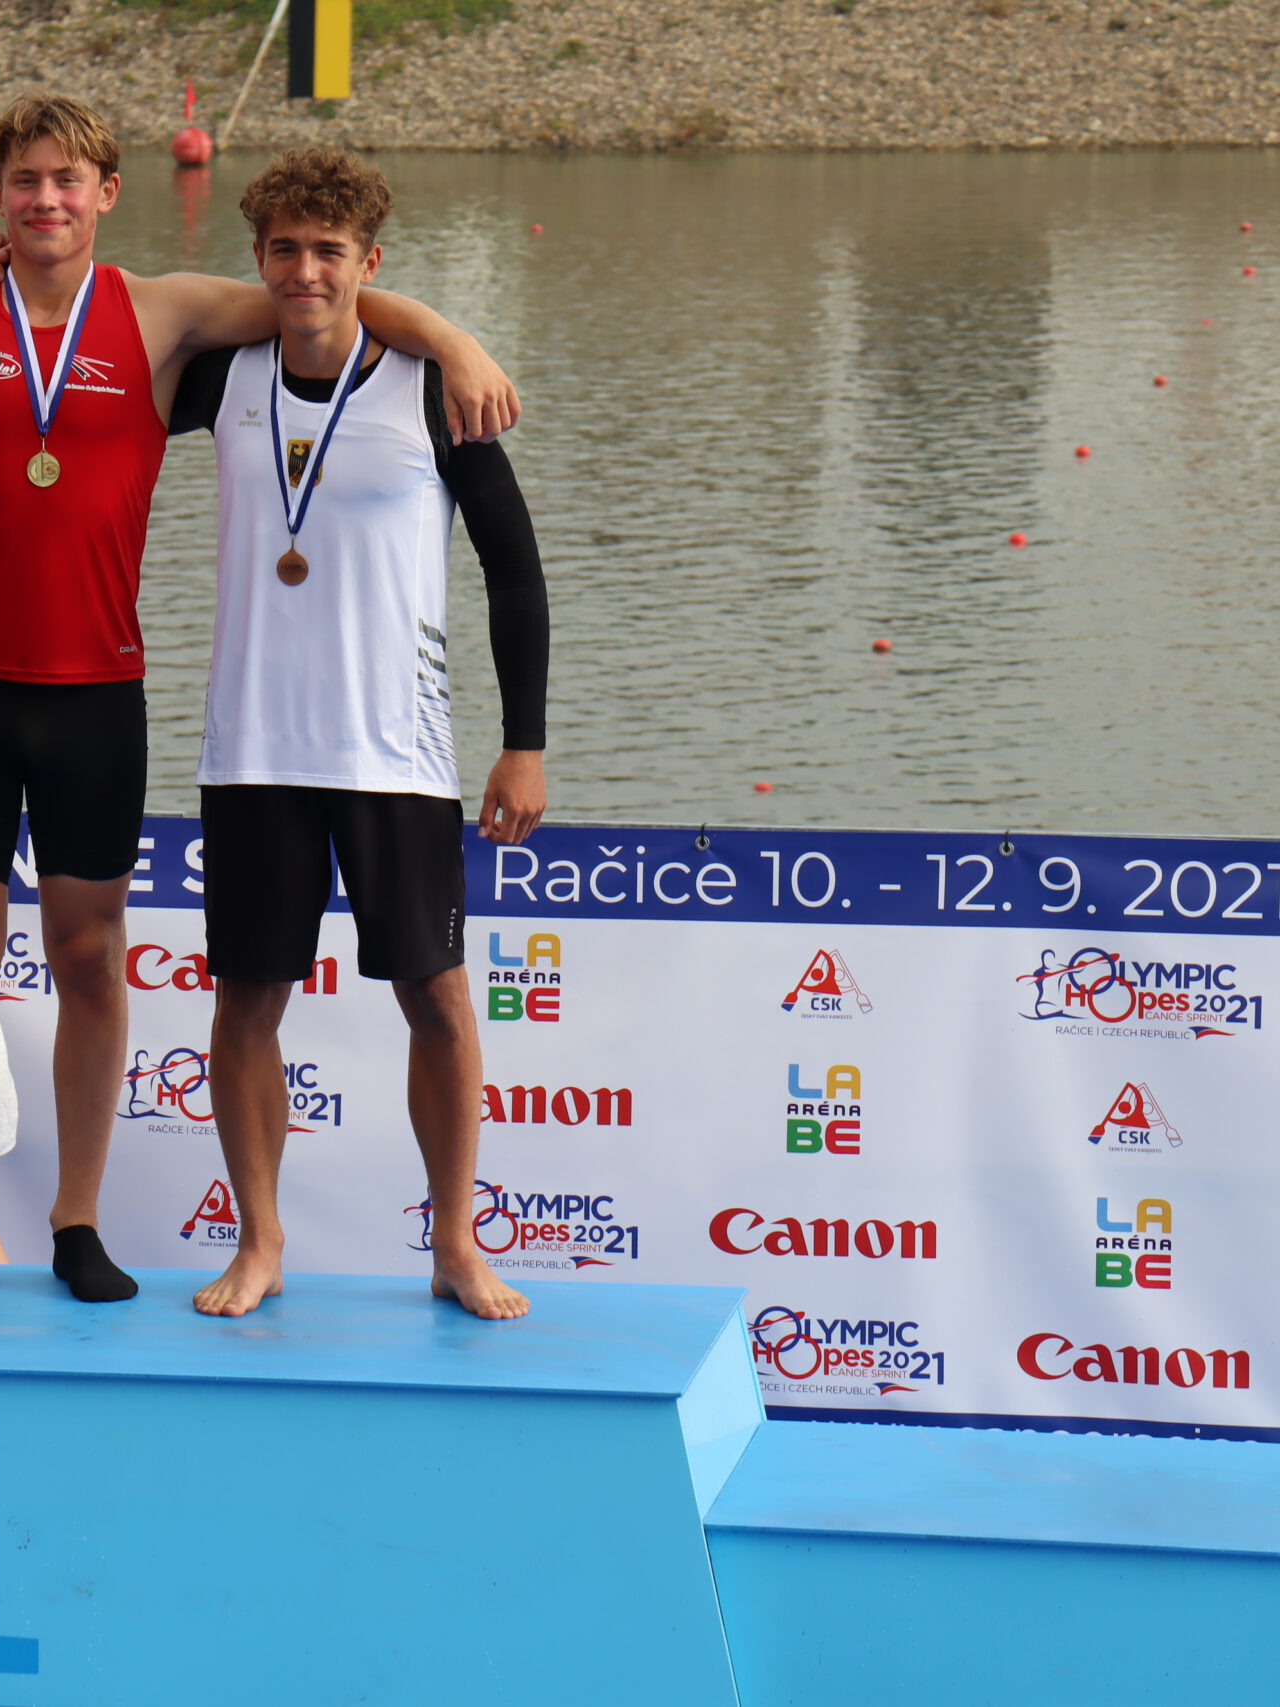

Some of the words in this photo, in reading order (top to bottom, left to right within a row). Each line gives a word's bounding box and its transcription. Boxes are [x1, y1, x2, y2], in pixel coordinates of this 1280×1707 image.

[494, 845, 737, 906] Račice
[760, 851, 851, 908] 10.
[879, 883, 901, 891] -
[926, 854, 1012, 912] 12.
[1038, 856, 1096, 914] 9.
[489, 932, 561, 967] LA
[126, 944, 337, 994] Can
[1068, 947, 1236, 995] OLYMPIC
[488, 987, 560, 1022] BE
[811, 993, 842, 1011] ČSK
[1145, 1011, 1183, 1021] CANOE
[1186, 1012, 1224, 1023] SPRINT
[1193, 994, 1262, 1029] 2021
[1055, 1025, 1093, 1035] RAČICE
[1102, 1027, 1137, 1037] CZECH
[1140, 1029, 1191, 1040] REPUBLIC
[788, 1064, 861, 1099] LA
[288, 1093, 341, 1126] 021
[480, 1084, 632, 1127] anon
[148, 1124, 183, 1134] RAČICE
[192, 1126, 217, 1135] CZEC
[786, 1119, 860, 1155] BE
[1097, 1197, 1172, 1233] LA
[473, 1207, 570, 1254] Opes
[573, 1225, 638, 1259] 2021
[527, 1243, 564, 1251] CANOE
[566, 1243, 603, 1253] SPRINT
[709, 1208, 937, 1259] Canon
[486, 1259, 519, 1268] CZECH
[522, 1259, 571, 1270] REPUBLIC
[1095, 1252, 1171, 1289] BE
[754, 1306, 919, 1352] OLYMPIC
[830, 1367, 868, 1377] CANOE
[871, 1369, 907, 1379] SPRINT
[878, 1351, 944, 1385] 2021
[1016, 1332, 1250, 1389] Canon
[788, 1384, 823, 1393] CZECH
[825, 1385, 875, 1396] REPUBLIC
